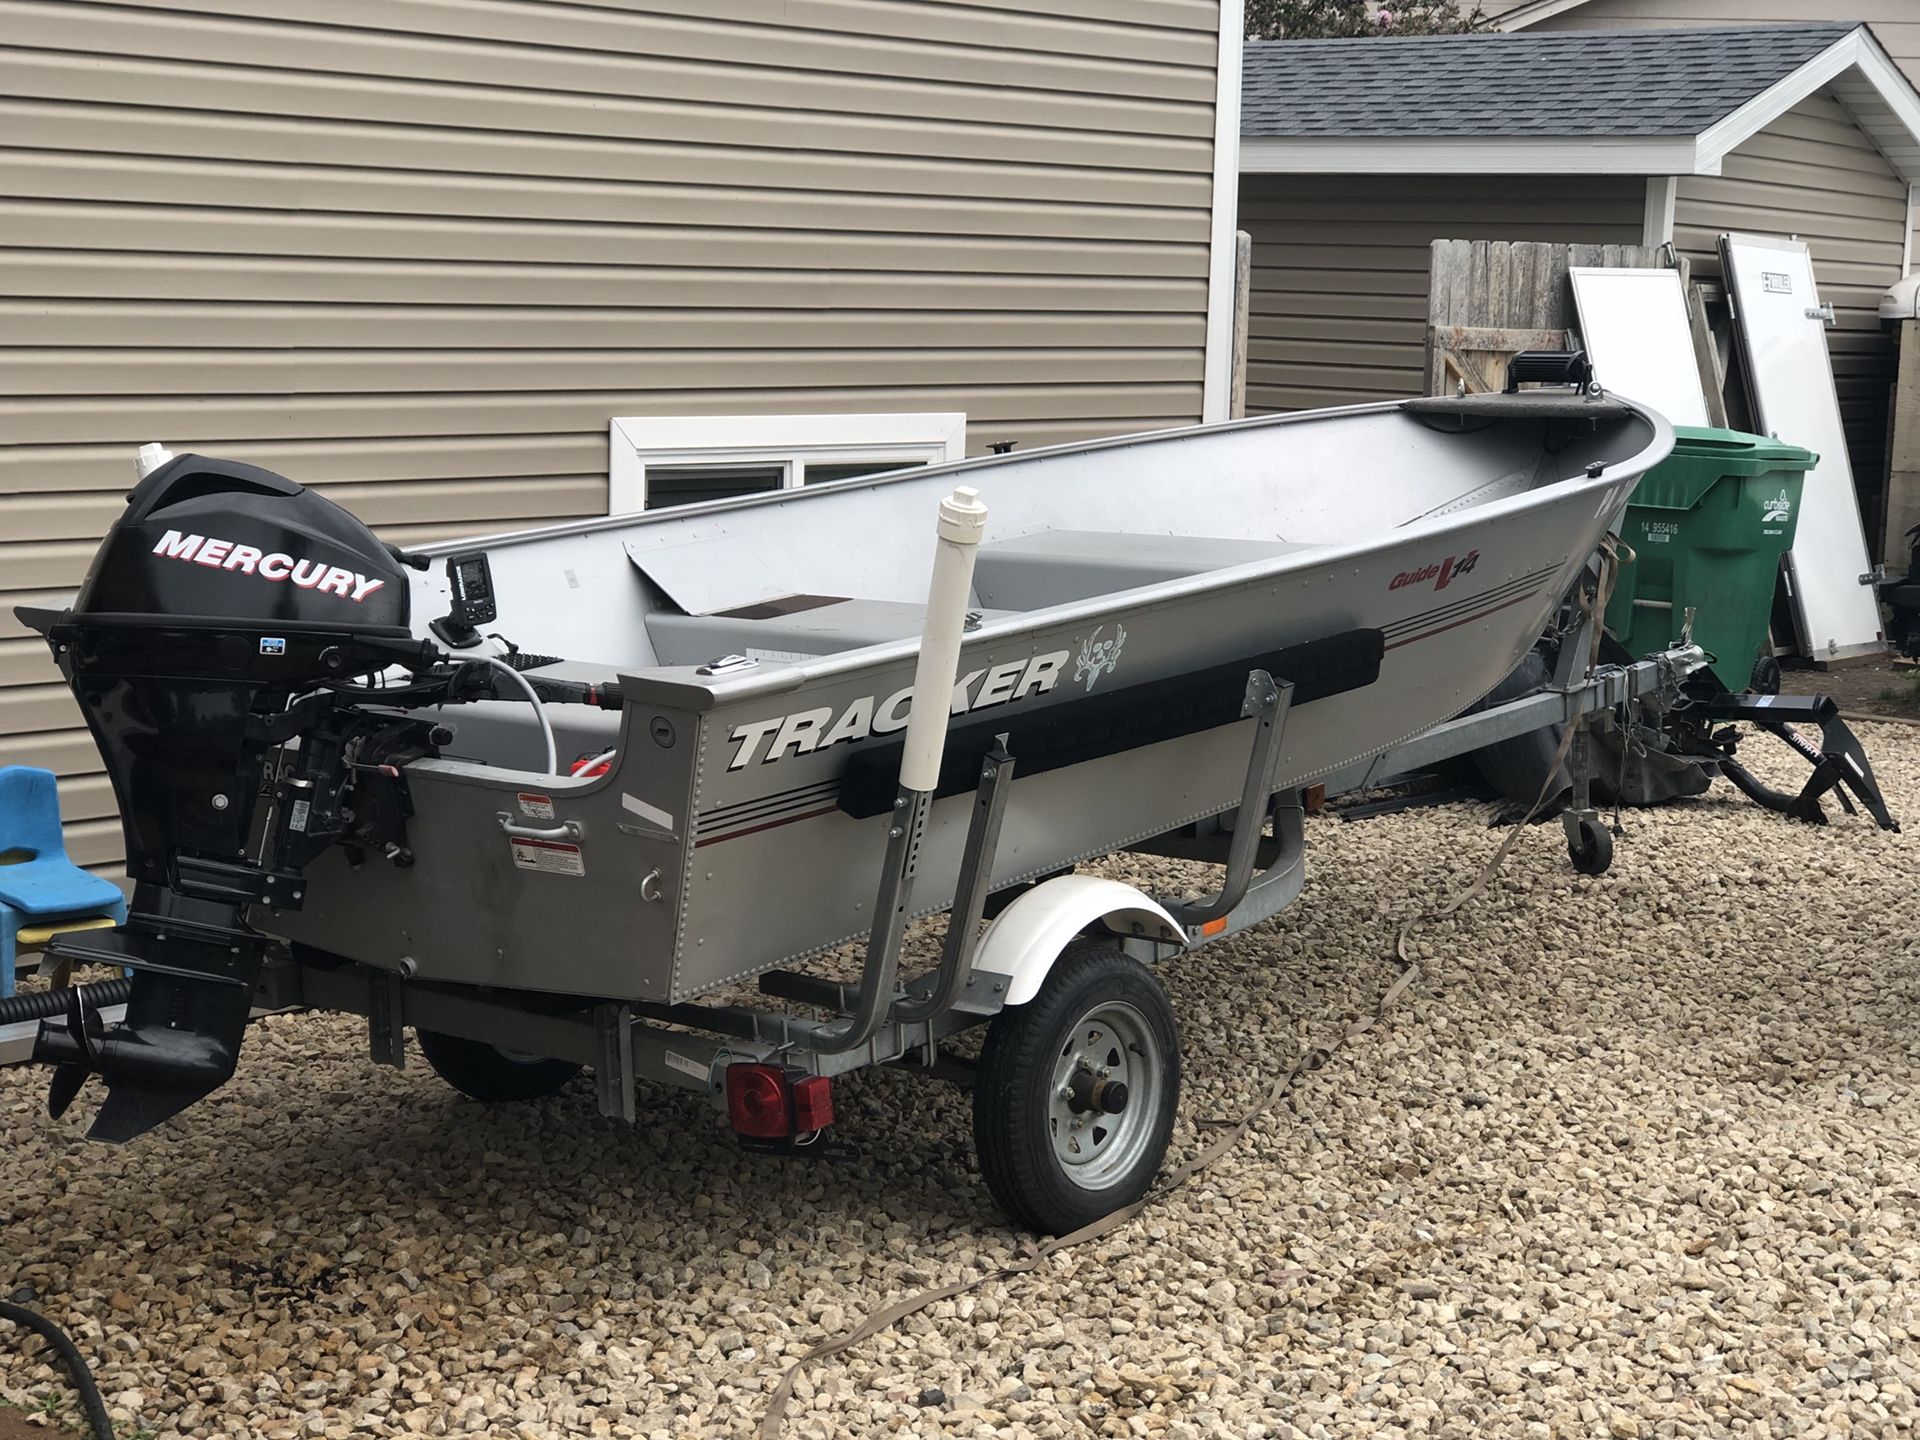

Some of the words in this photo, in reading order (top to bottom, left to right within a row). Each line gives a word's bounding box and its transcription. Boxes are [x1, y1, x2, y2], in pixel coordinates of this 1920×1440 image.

[1641, 521, 1649, 532] 14
[152, 529, 385, 604] MERCURY
[1389, 563, 1439, 591] Guide
[726, 650, 1071, 774] TRACKER
